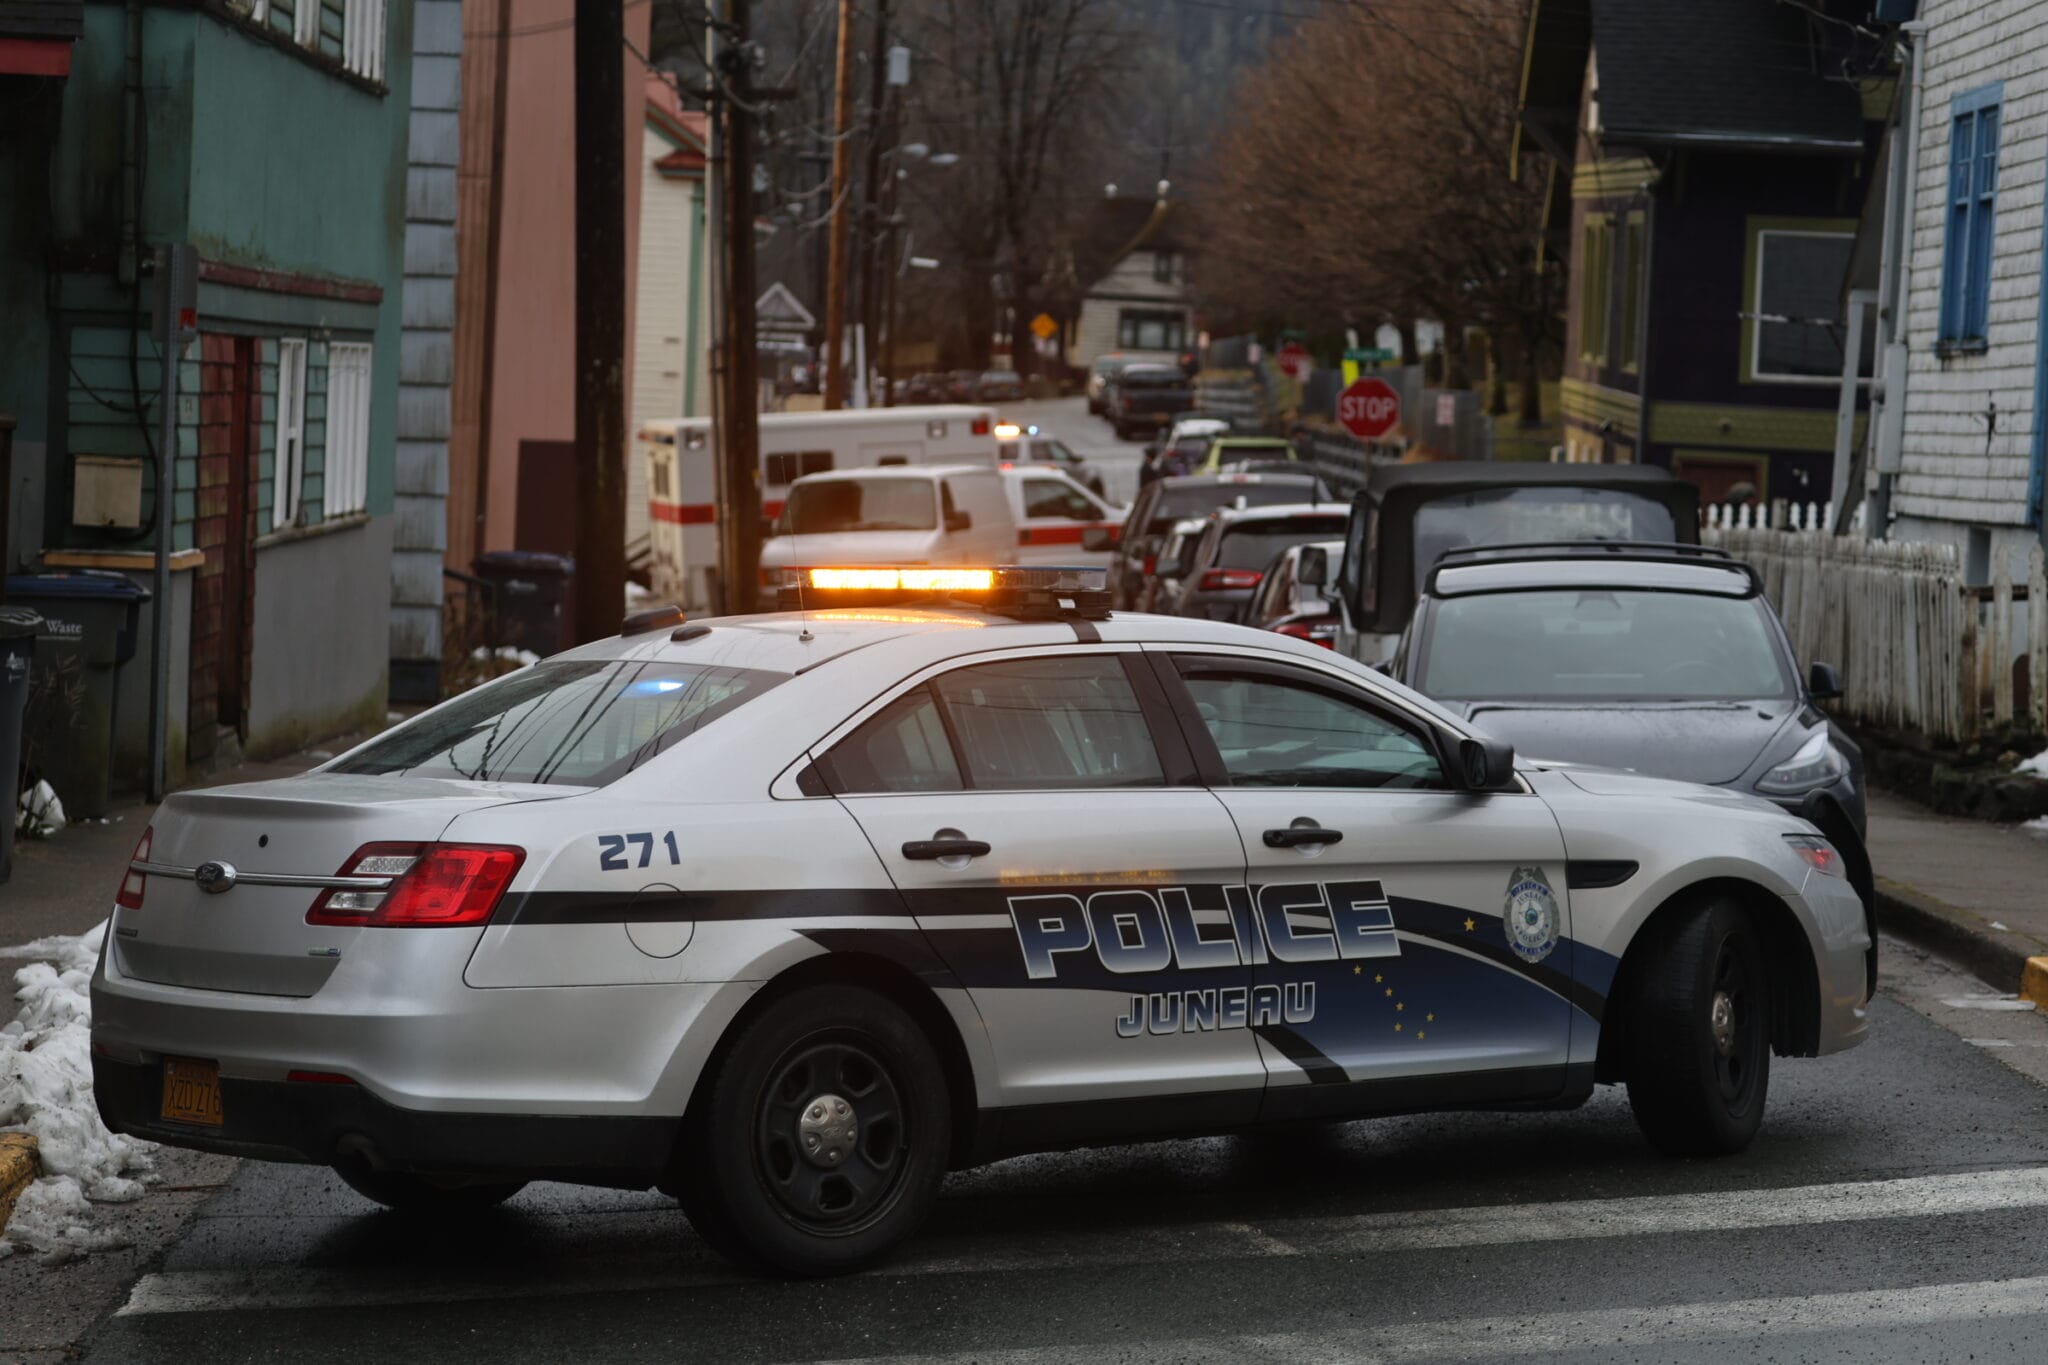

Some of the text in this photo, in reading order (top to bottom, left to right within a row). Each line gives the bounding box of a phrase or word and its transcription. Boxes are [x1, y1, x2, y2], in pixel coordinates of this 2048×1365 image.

[1343, 396, 1395, 420] STOP
[46, 619, 82, 633] Waste
[598, 831, 681, 871] 271
[1516, 891, 1545, 905] JUNEAU
[1007, 880, 1401, 979] POLICE
[1518, 929, 1546, 943] POLICE
[1116, 982, 1316, 1038] JUNEAU
